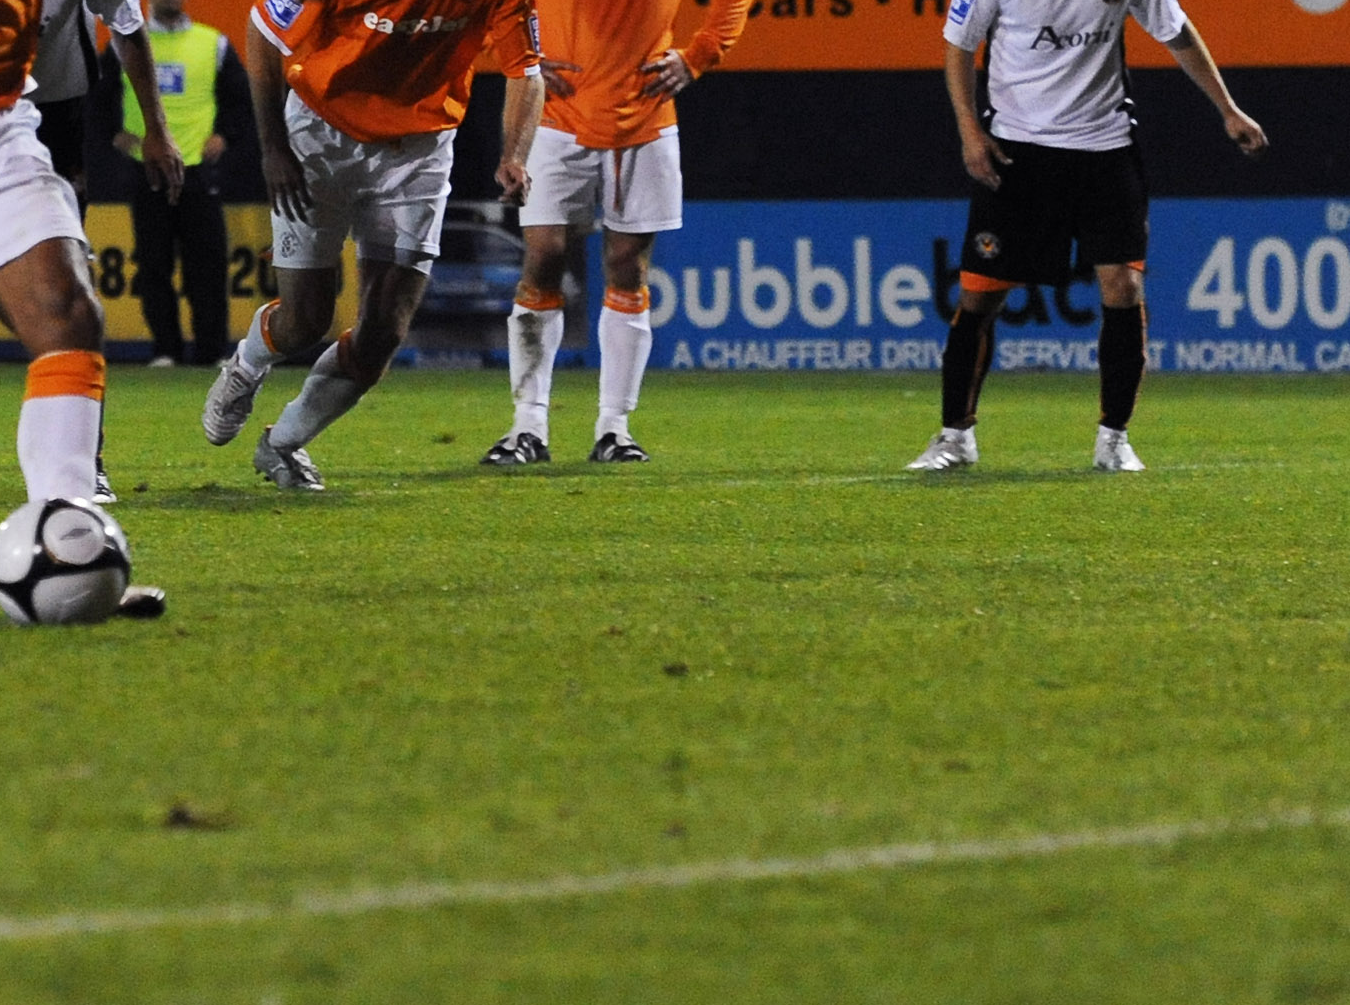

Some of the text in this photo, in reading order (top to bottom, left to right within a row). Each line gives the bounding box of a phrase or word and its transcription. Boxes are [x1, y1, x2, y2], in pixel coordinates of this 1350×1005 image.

[1186, 235, 1350, 329] 400
[672, 340, 695, 369] A
[701, 340, 872, 370] CHAUFFEUR
[999, 340, 1098, 370] SERVIC
[1175, 341, 1306, 371] NORMAL
